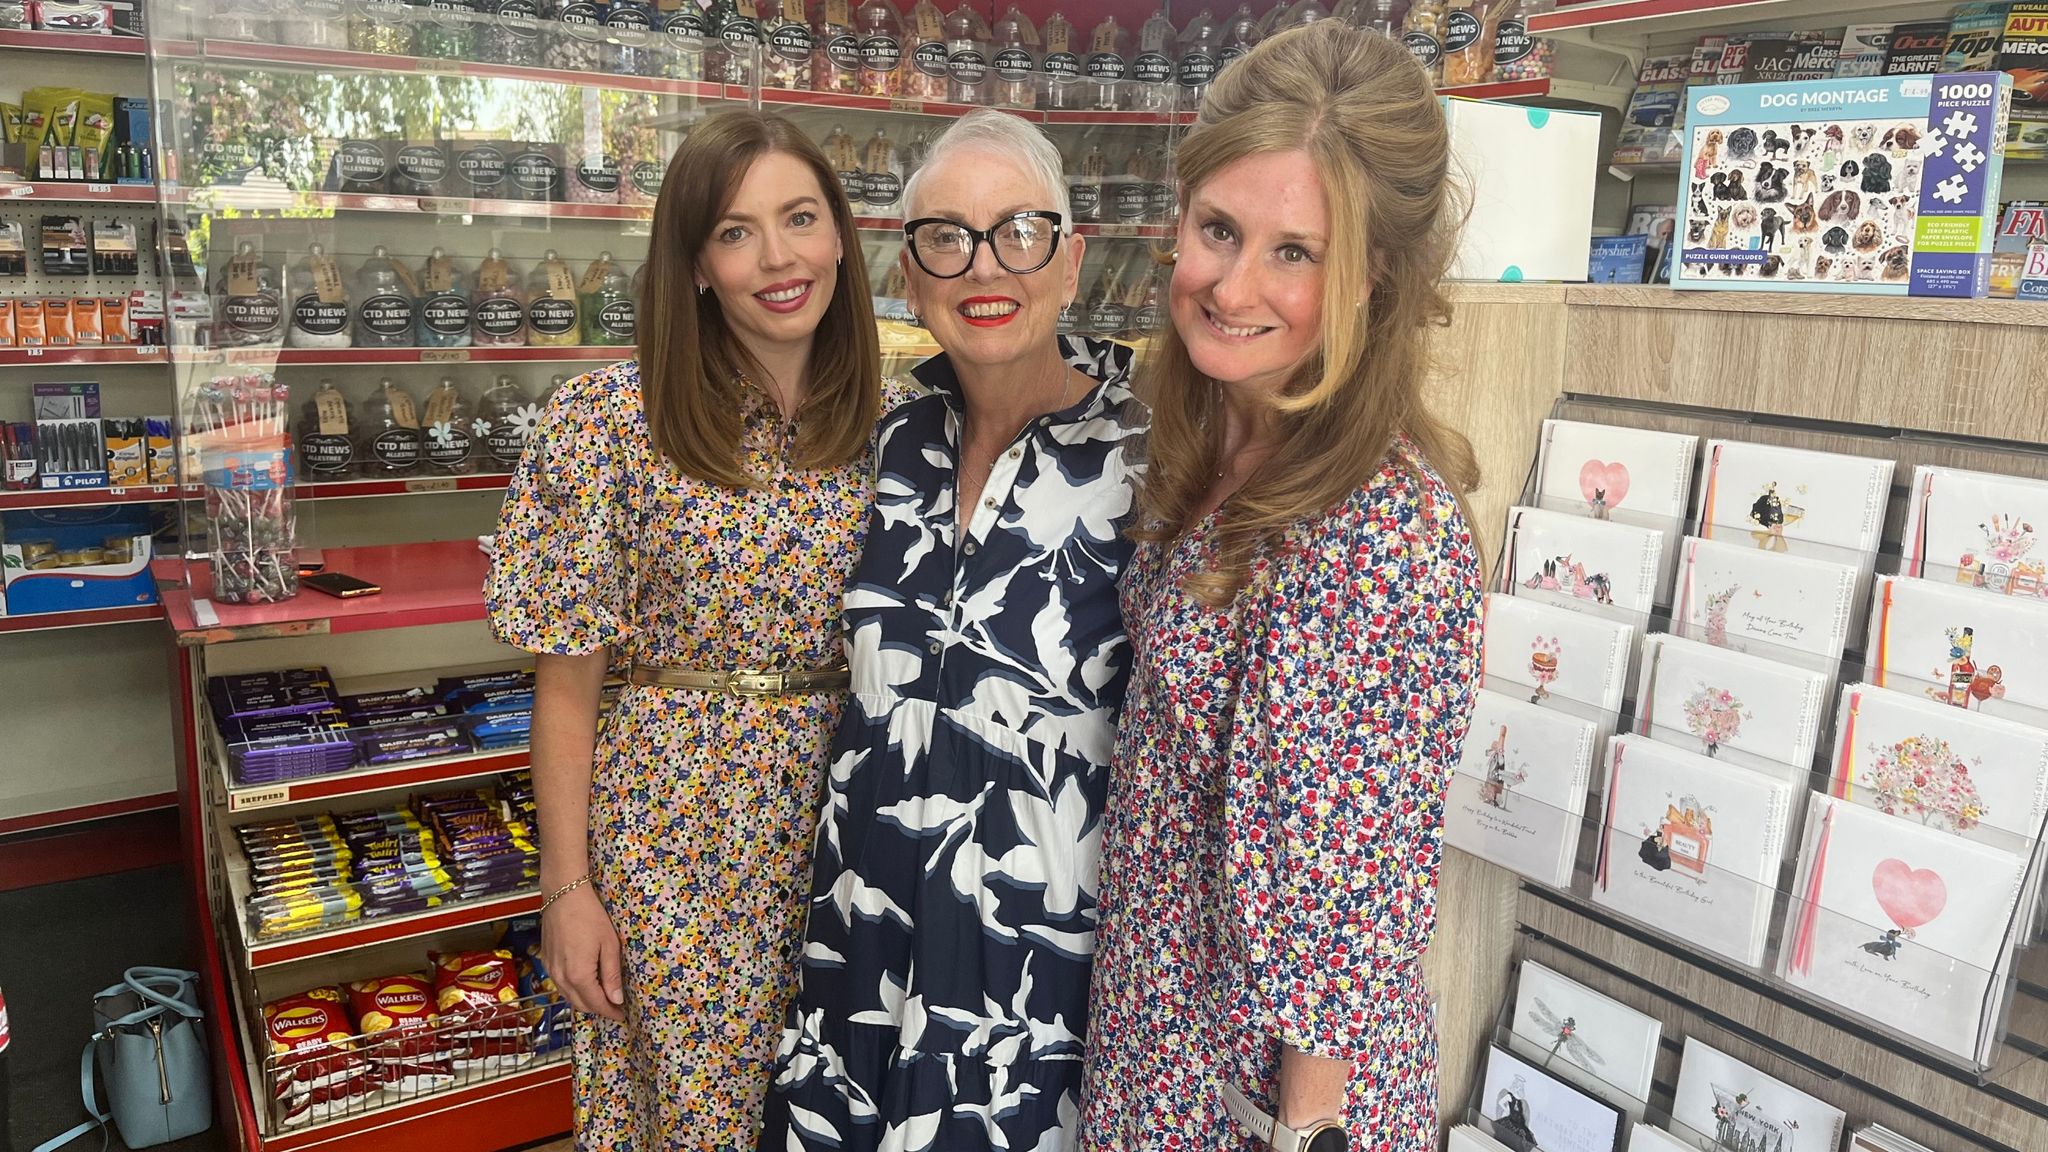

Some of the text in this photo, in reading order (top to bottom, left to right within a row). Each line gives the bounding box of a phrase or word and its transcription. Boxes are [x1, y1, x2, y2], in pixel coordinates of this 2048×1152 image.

[500, 10, 521, 19] CTD
[563, 14, 584, 23] CTD
[607, 21, 650, 32] CTD NEWS
[668, 26, 686, 35] CTD
[1450, 24, 1476, 34] NEWS
[723, 32, 741, 40] CTD
[773, 36, 791, 45] CTD
[1501, 35, 1530, 45] NEWS
[829, 46, 847, 54] CTD
[1410, 45, 1436, 54] NEWS
[916, 53, 932, 61] CTD
[950, 62, 986, 71] CTD NEWS
[1011, 60, 1032, 69] NEWS
[1046, 61, 1080, 71] CTD NEWS
[1102, 63, 1125, 72] NEWS
[1147, 64, 1170, 73] NEWS
[1191, 64, 1215, 73] NEWS
[1754, 57, 1792, 72] JAG
[1888, 61, 1926, 74] BARN
[1938, 84, 1993, 100] 1000
[1760, 88, 1889, 108] DOG MONTAGE
[1961, 99, 1990, 107] PUZZLE
[357, 156, 385, 167] NEWS
[398, 155, 446, 167] CTD NEWS
[459, 160, 505, 169] CTD NEWS
[531, 167, 557, 175] NEWS
[877, 184, 899, 192] NEWS
[1075, 193, 1097, 201] NEWS
[1127, 195, 1148, 203] NEWS
[227, 305, 279, 316] CTD NEWS
[296, 308, 346, 317] CTD NEWS
[363, 310, 411, 318] CTD NEWS
[425, 309, 469, 318] CTD NEWS
[477, 310, 522, 320] CTD NEWS
[548, 310, 575, 318] NEWS
[602, 313, 621, 321] CTD
[377, 442, 397, 450] CTD
[488, 438, 506, 446] CTD
[320, 445, 350, 454] NEWS
[75, 477, 102, 485] PILOT
[484, 689, 510, 697] DAIRY
[369, 716, 397, 725] DAIRY
[240, 791, 285, 804] SHEPHERD
[1675, 839, 1696, 851] BEAUTY
[1900, 979, 1931, 999] Birthday
[377, 992, 426, 1006] WALKERS
[274, 1014, 326, 1031] WALKERS
[398, 1017, 423, 1026] READY
[296, 1037, 323, 1049] READY
[1741, 1109, 1780, 1134] NEW YORK
